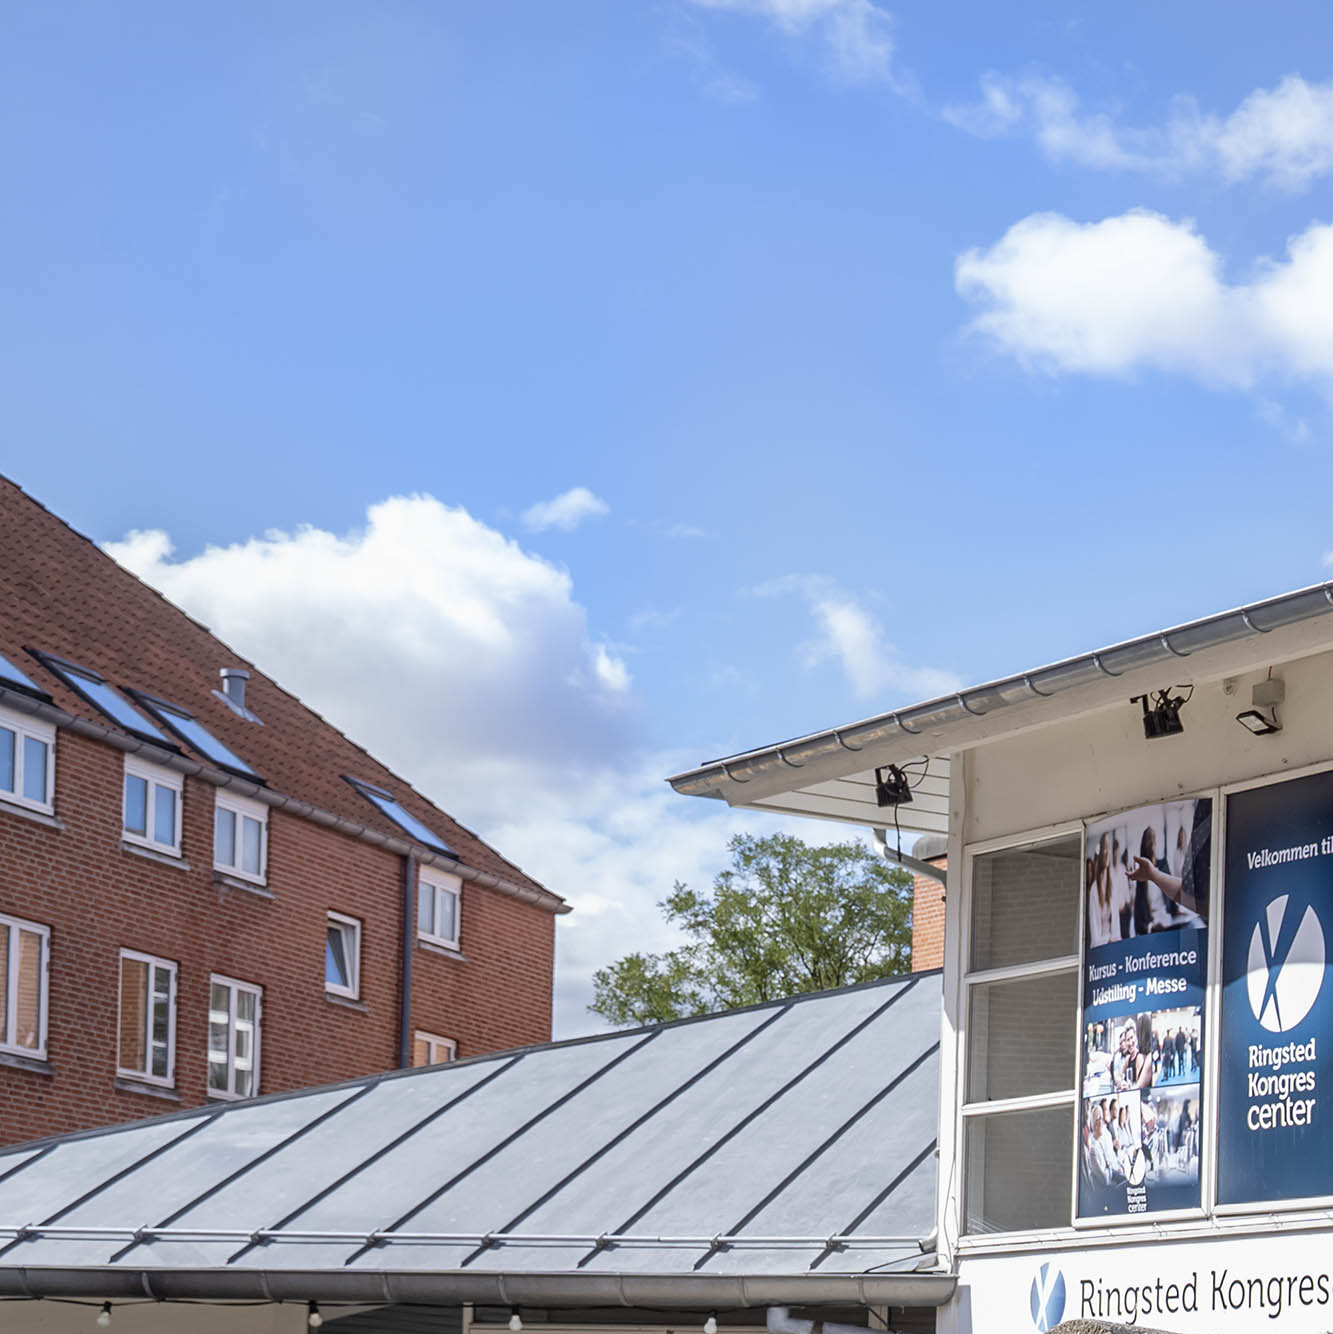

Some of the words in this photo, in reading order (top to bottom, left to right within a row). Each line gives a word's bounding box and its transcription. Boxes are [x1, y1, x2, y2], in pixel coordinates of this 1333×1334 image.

[1247, 842, 1319, 870] Velkommen
[1089, 963, 1117, 982] Kursus
[1125, 950, 1197, 973] Konference
[1092, 984, 1136, 1006] Udstilling
[1145, 977, 1187, 996] Messe
[1248, 1037, 1316, 1070] Ringsted
[1248, 1071, 1316, 1100] Kongres
[1247, 1097, 1316, 1131] center
[1080, 1271, 1198, 1325] Ringsted
